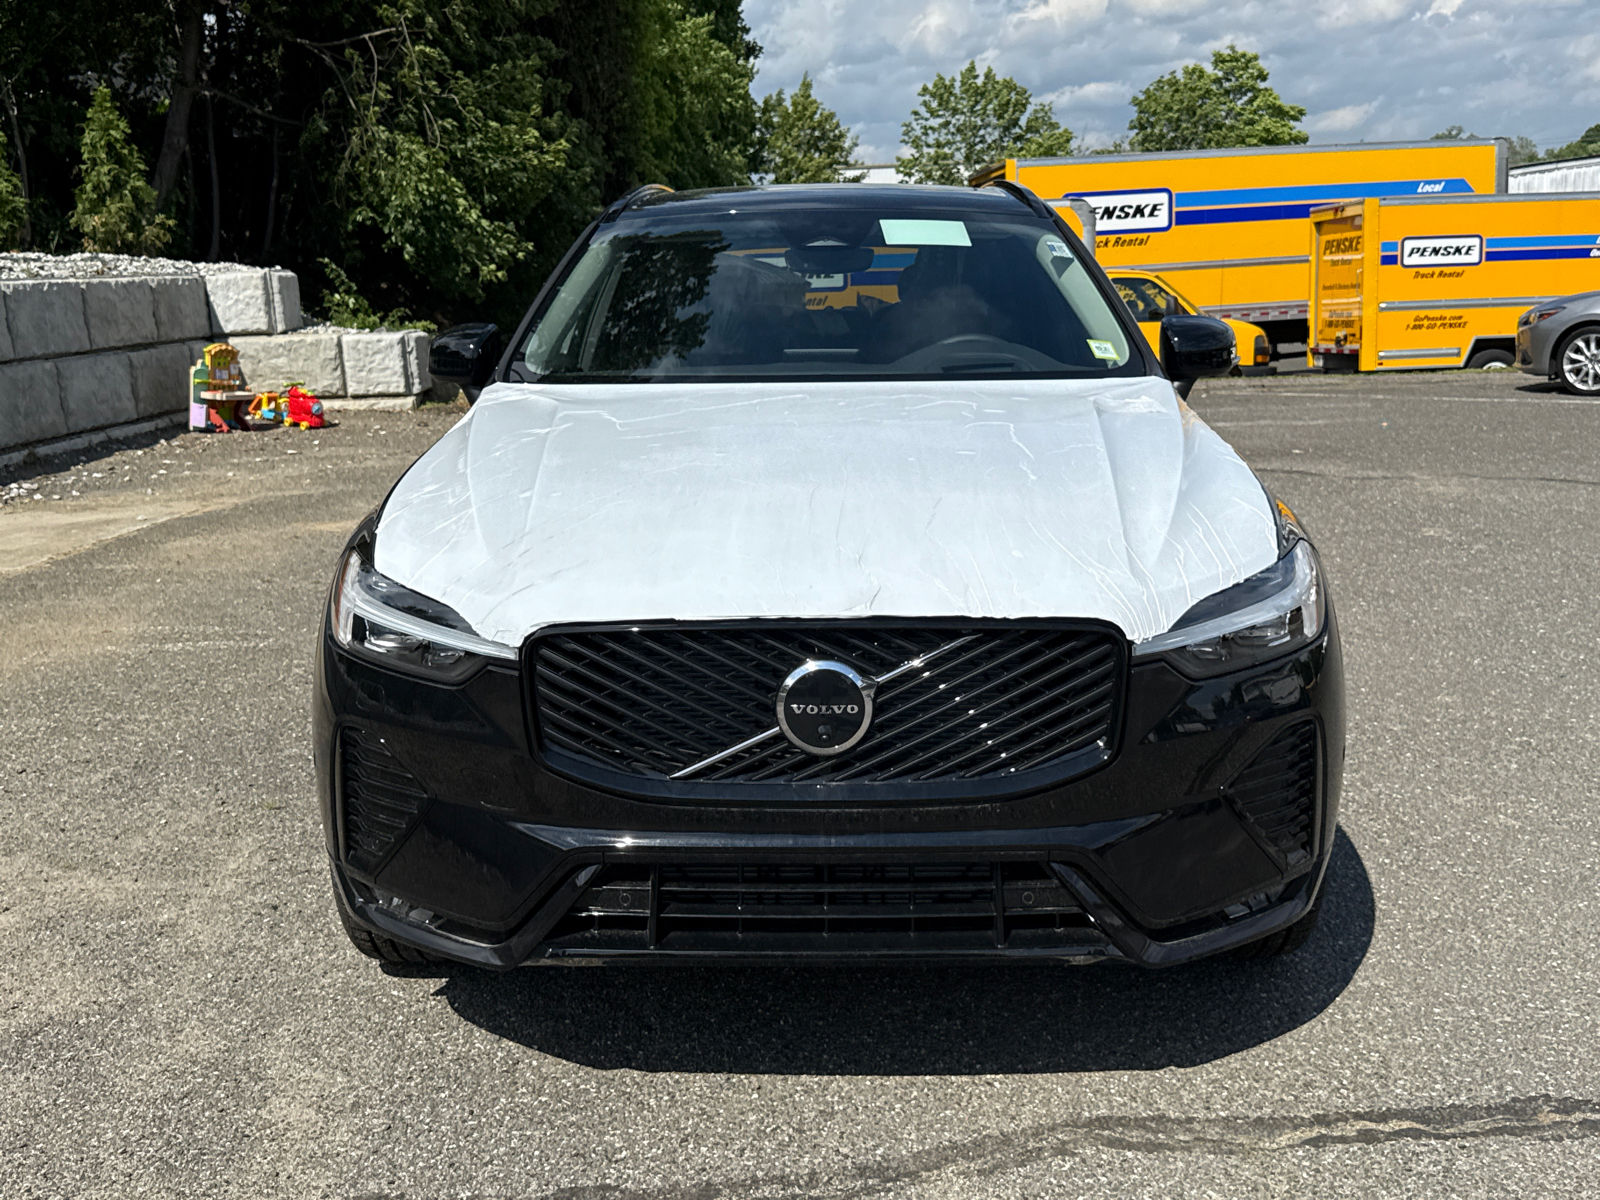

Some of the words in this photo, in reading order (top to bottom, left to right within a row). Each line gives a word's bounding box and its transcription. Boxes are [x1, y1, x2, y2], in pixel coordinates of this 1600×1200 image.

[1417, 181, 1445, 193] Local
[1092, 203, 1164, 220] ENSKE
[1112, 235, 1150, 248] Rental
[1323, 236, 1362, 255] PENSKE
[1407, 245, 1476, 257] PENSKE
[1413, 271, 1435, 279] Truck
[1437, 270, 1464, 278] Rental
[790, 704, 859, 714] VOLVO
